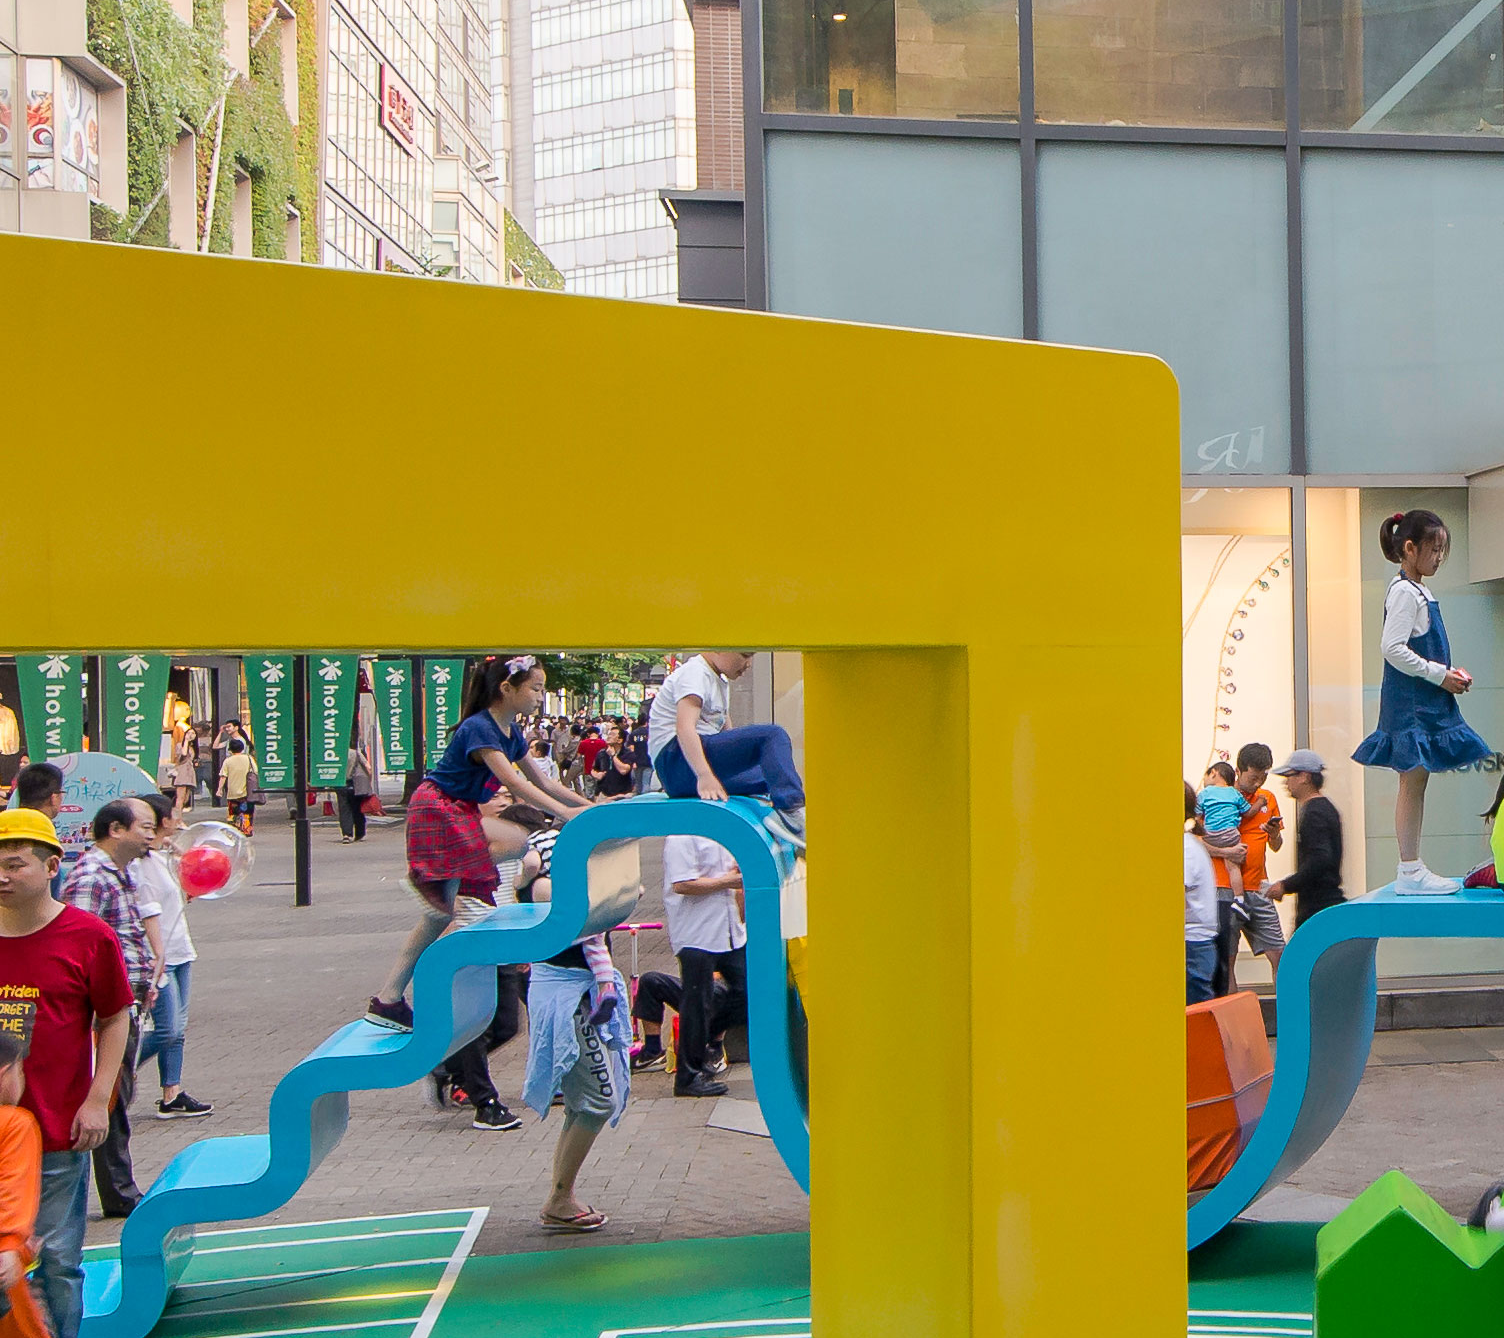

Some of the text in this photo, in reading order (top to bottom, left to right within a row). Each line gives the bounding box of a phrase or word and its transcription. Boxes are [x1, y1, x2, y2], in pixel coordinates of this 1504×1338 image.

[45, 684, 68, 761] hotwi
[123, 681, 146, 766] hotwin
[265, 686, 282, 764] hotwind
[322, 684, 340, 762] hotwind
[389, 688, 404, 755] hotwind
[435, 686, 450, 750] hotwind
[581, 1023, 614, 1098] adidas
